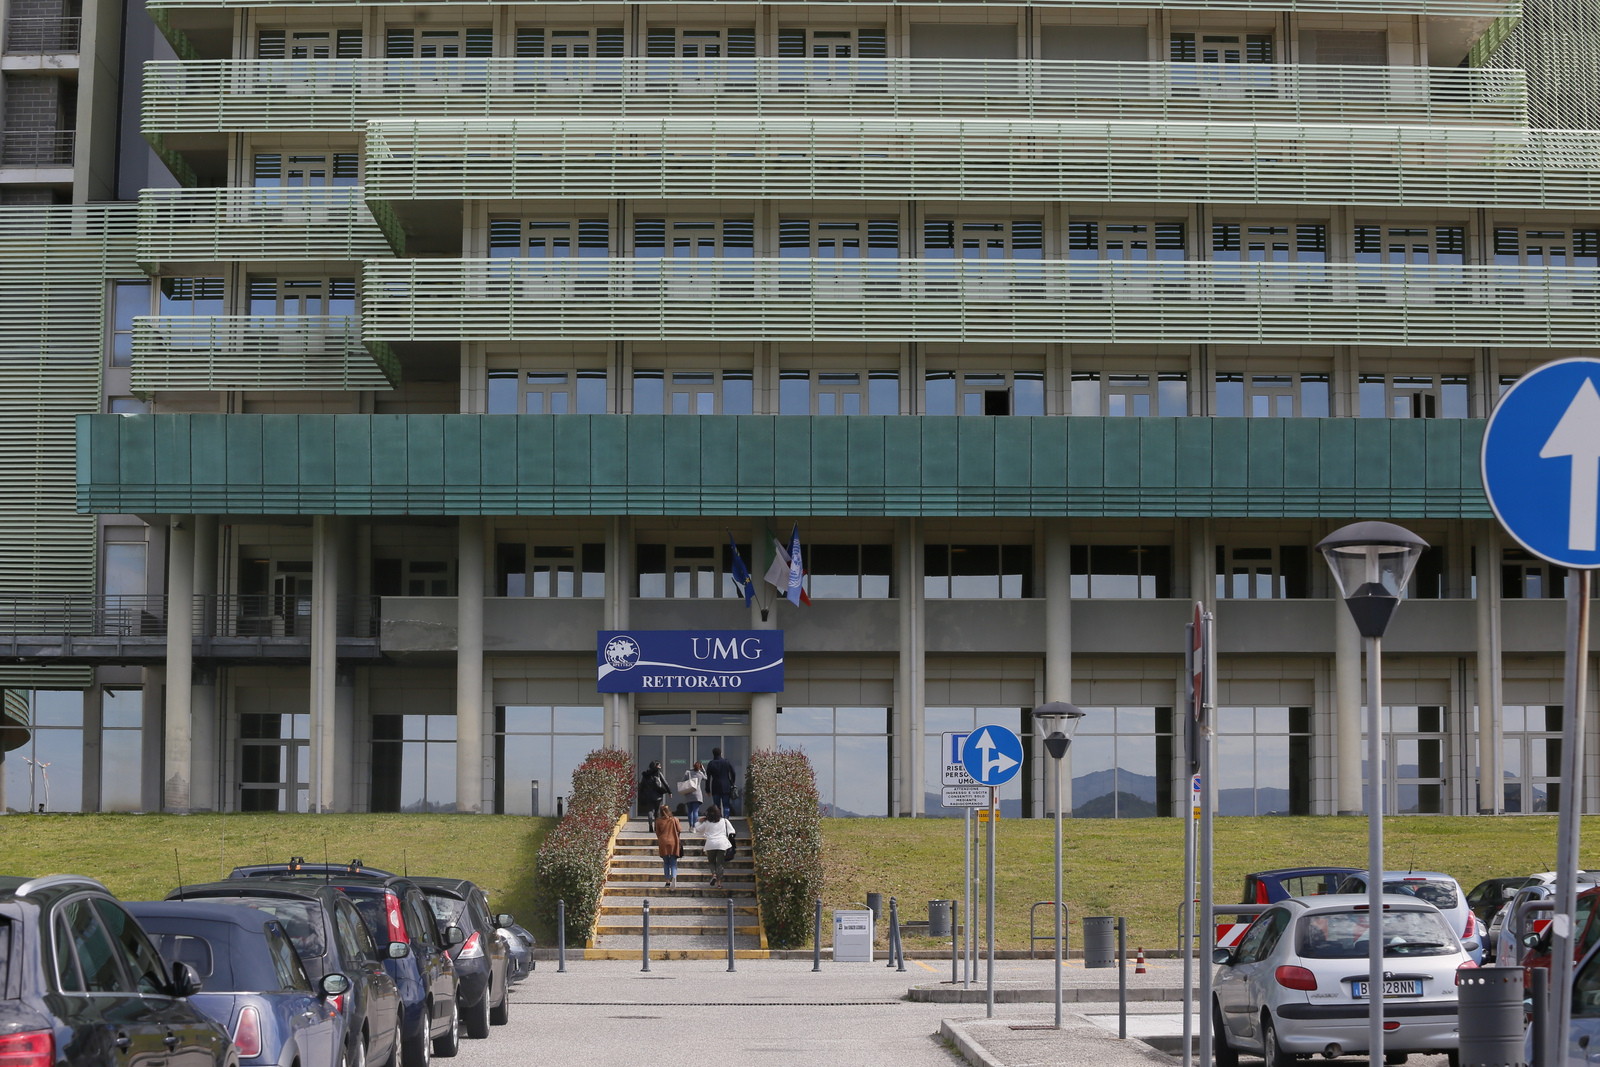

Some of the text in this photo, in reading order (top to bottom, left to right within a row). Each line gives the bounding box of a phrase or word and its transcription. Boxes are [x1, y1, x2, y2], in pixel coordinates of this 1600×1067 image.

[691, 637, 763, 660] UMG
[642, 675, 742, 688] RETTORATO
[1361, 981, 1414, 994] B28NN
